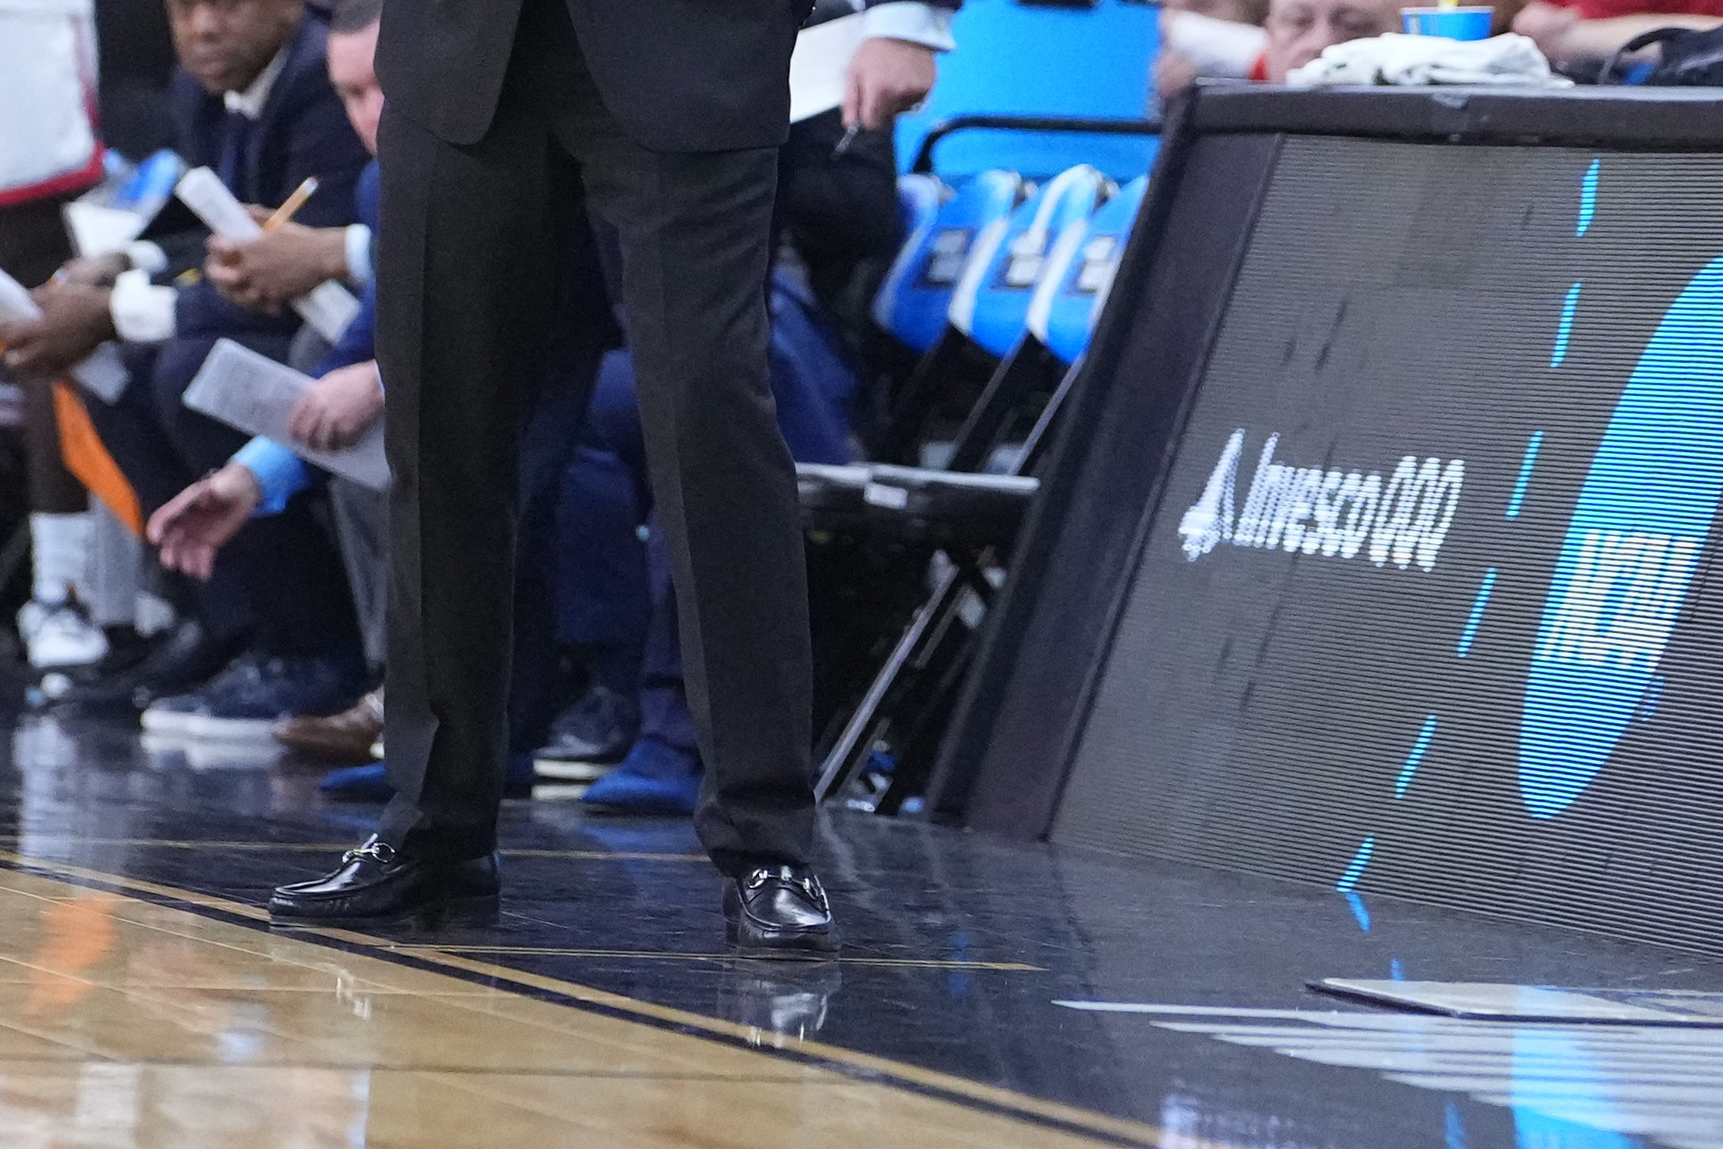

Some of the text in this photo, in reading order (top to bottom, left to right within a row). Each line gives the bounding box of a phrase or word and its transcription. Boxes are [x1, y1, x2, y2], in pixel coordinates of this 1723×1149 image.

[1233, 431, 1466, 572] Invesco QQQ
[1538, 527, 1700, 674] NCAA
